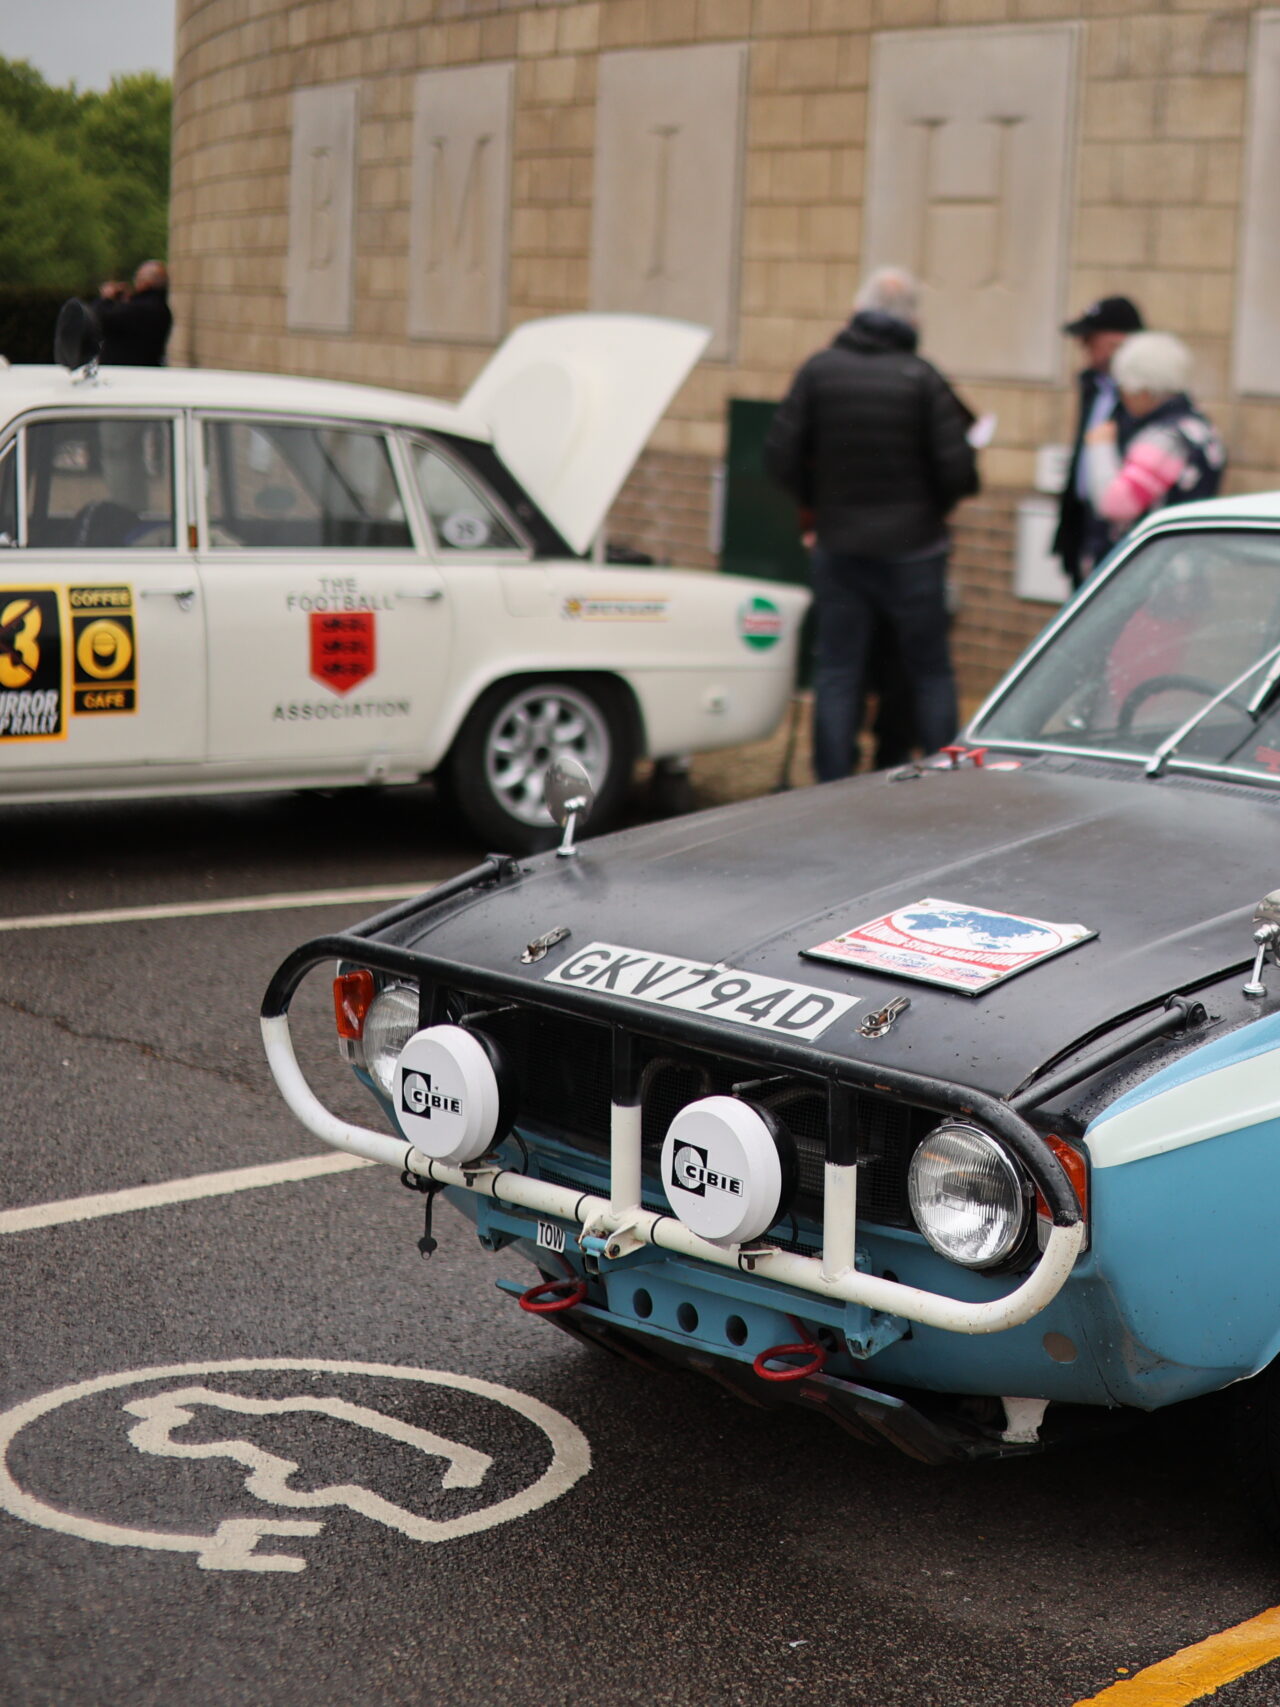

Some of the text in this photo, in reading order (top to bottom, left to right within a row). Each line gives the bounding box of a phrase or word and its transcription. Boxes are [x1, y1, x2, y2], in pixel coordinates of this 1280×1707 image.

[904, 115, 1030, 289] H
[71, 589, 130, 606] COFFEE
[318, 578, 358, 595] THE
[286, 593, 395, 612] FOOTBALL
[272, 700, 411, 721] ASSOCIATION
[11, 713, 58, 736] RALLY
[559, 949, 835, 1031] GKV794D
[539, 1223, 564, 1249] TOW
